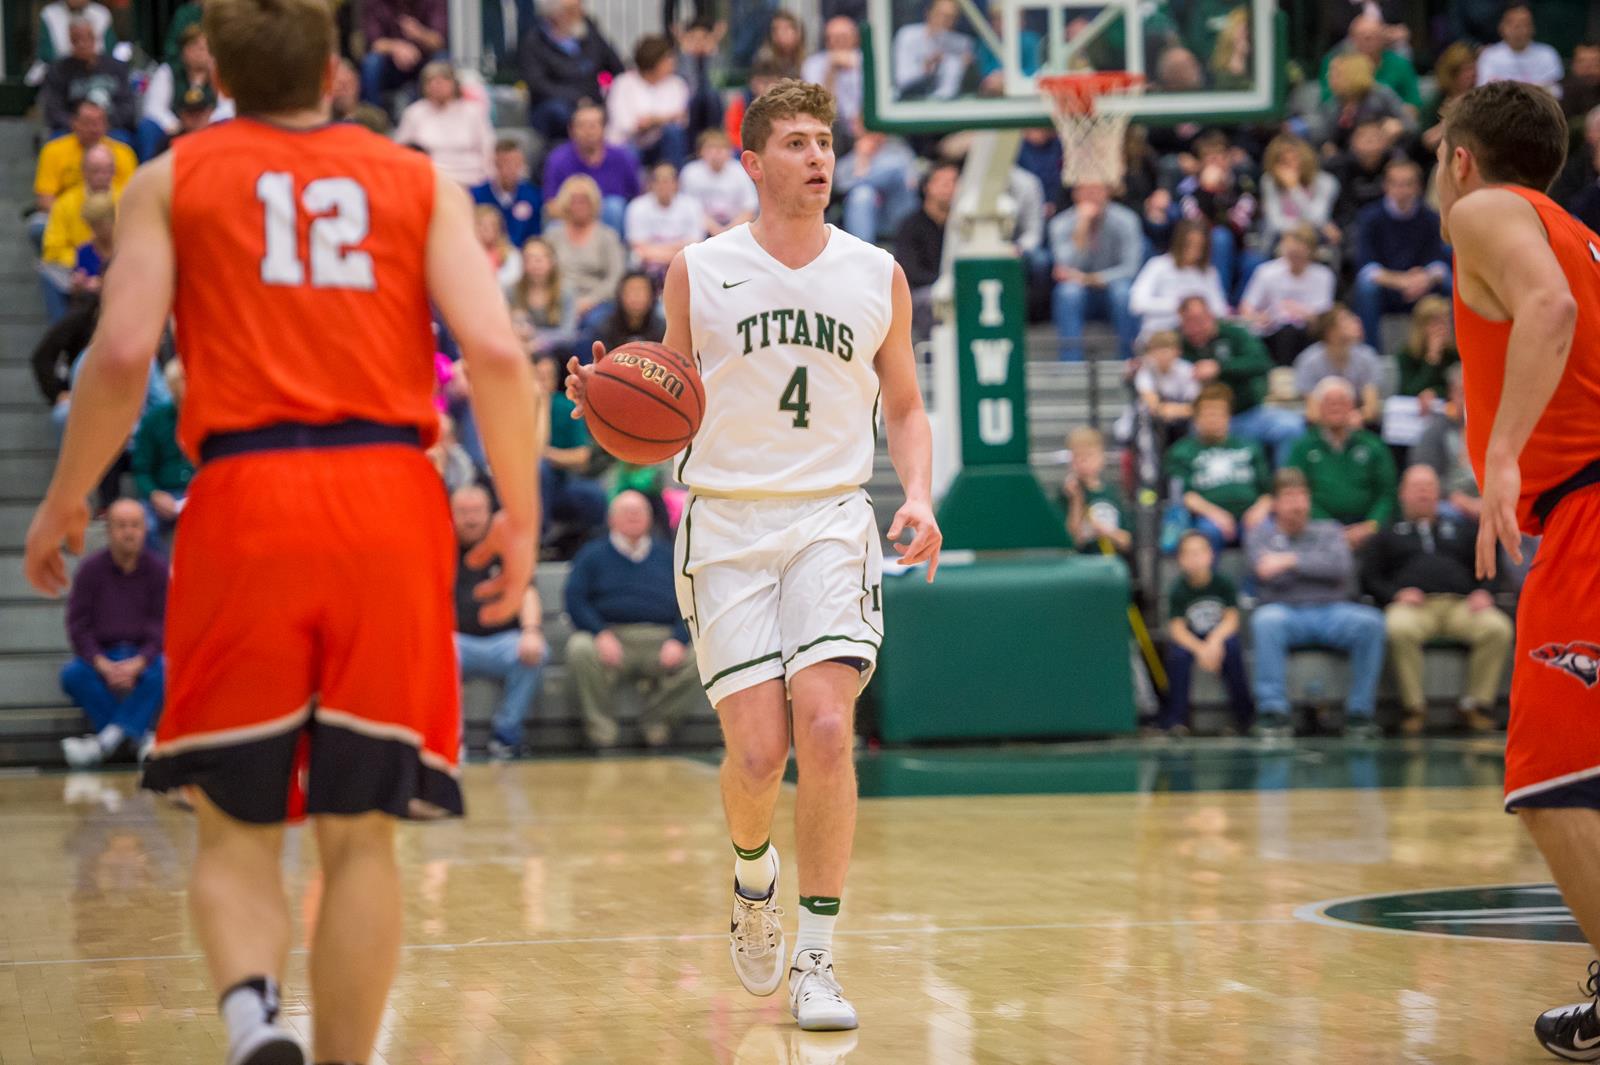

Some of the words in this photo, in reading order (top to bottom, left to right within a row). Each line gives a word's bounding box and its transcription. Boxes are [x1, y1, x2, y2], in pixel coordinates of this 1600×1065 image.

[256, 171, 377, 290] 12
[736, 308, 854, 362] TITANS
[612, 353, 685, 400] Wilson
[778, 365, 811, 429] 4
